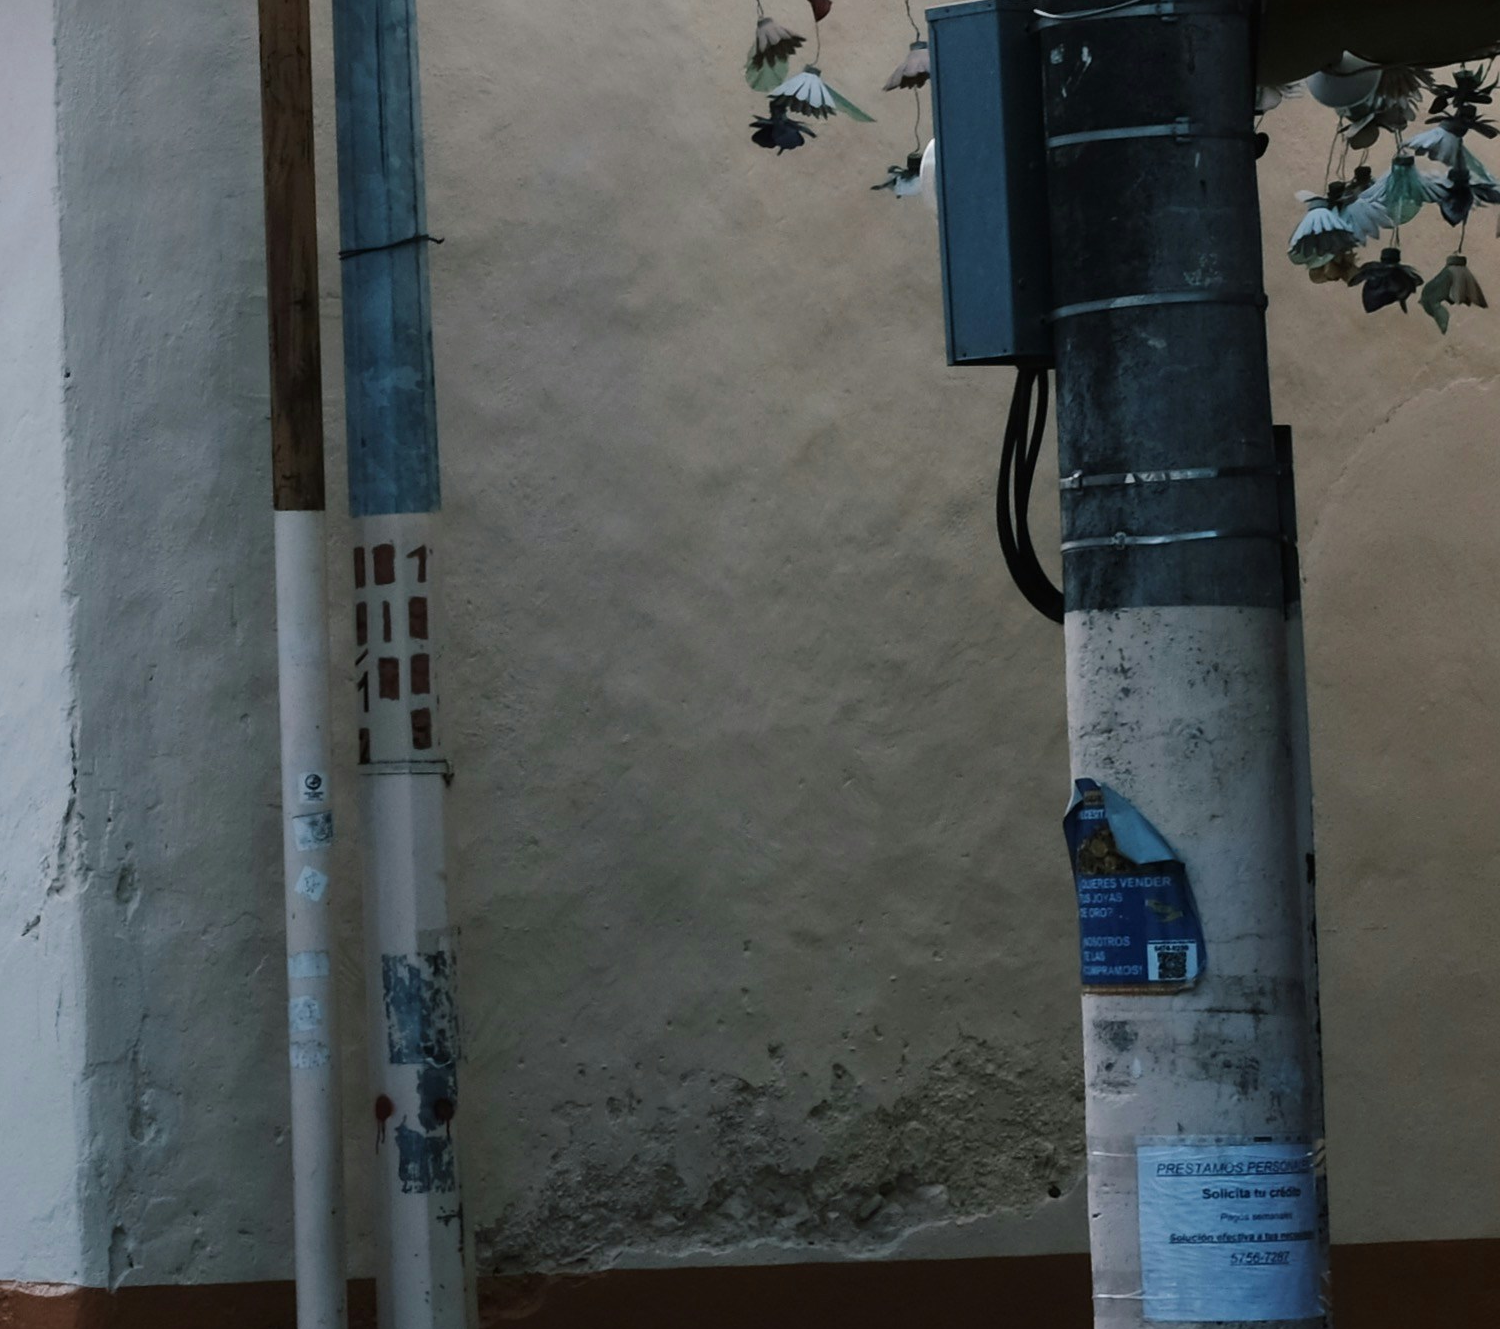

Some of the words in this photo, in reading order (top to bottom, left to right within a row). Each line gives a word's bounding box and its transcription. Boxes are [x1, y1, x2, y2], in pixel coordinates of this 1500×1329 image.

[1119, 875, 1173, 889] VENDER
[1092, 891, 1124, 904] JOYAS
[1156, 1161, 1245, 1176] PRESTAMOS
[1202, 1187, 1251, 1201] Solicita
[1254, 1187, 1267, 1199] tu
[1169, 1231, 1215, 1245] Solución
